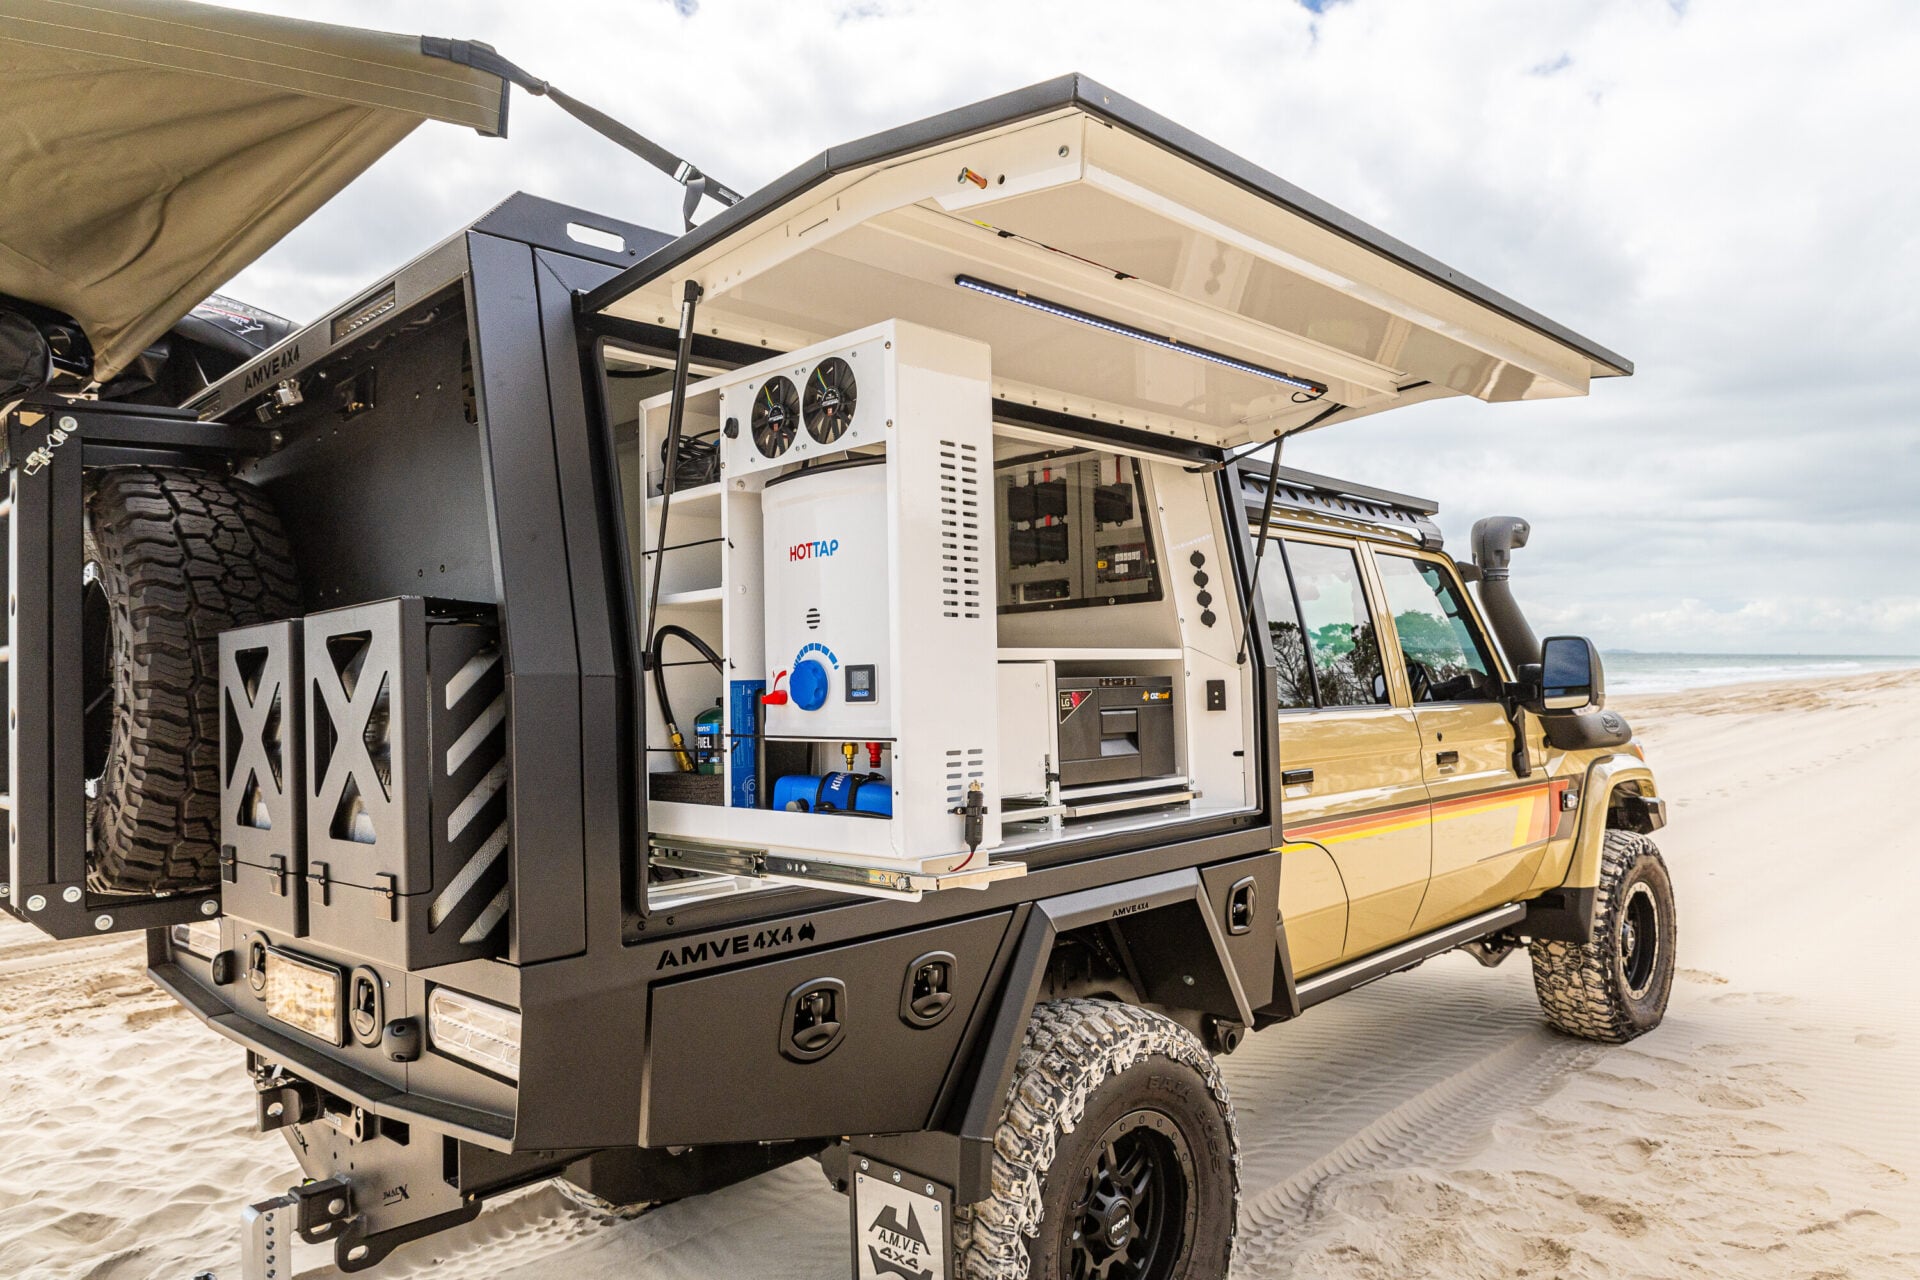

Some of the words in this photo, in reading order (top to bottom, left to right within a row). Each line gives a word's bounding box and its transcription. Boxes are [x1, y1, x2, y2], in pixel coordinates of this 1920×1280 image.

[789, 539, 839, 562] HOTTAP
[1061, 698, 1071, 707] LG
[1111, 1214, 1130, 1234] ROH
